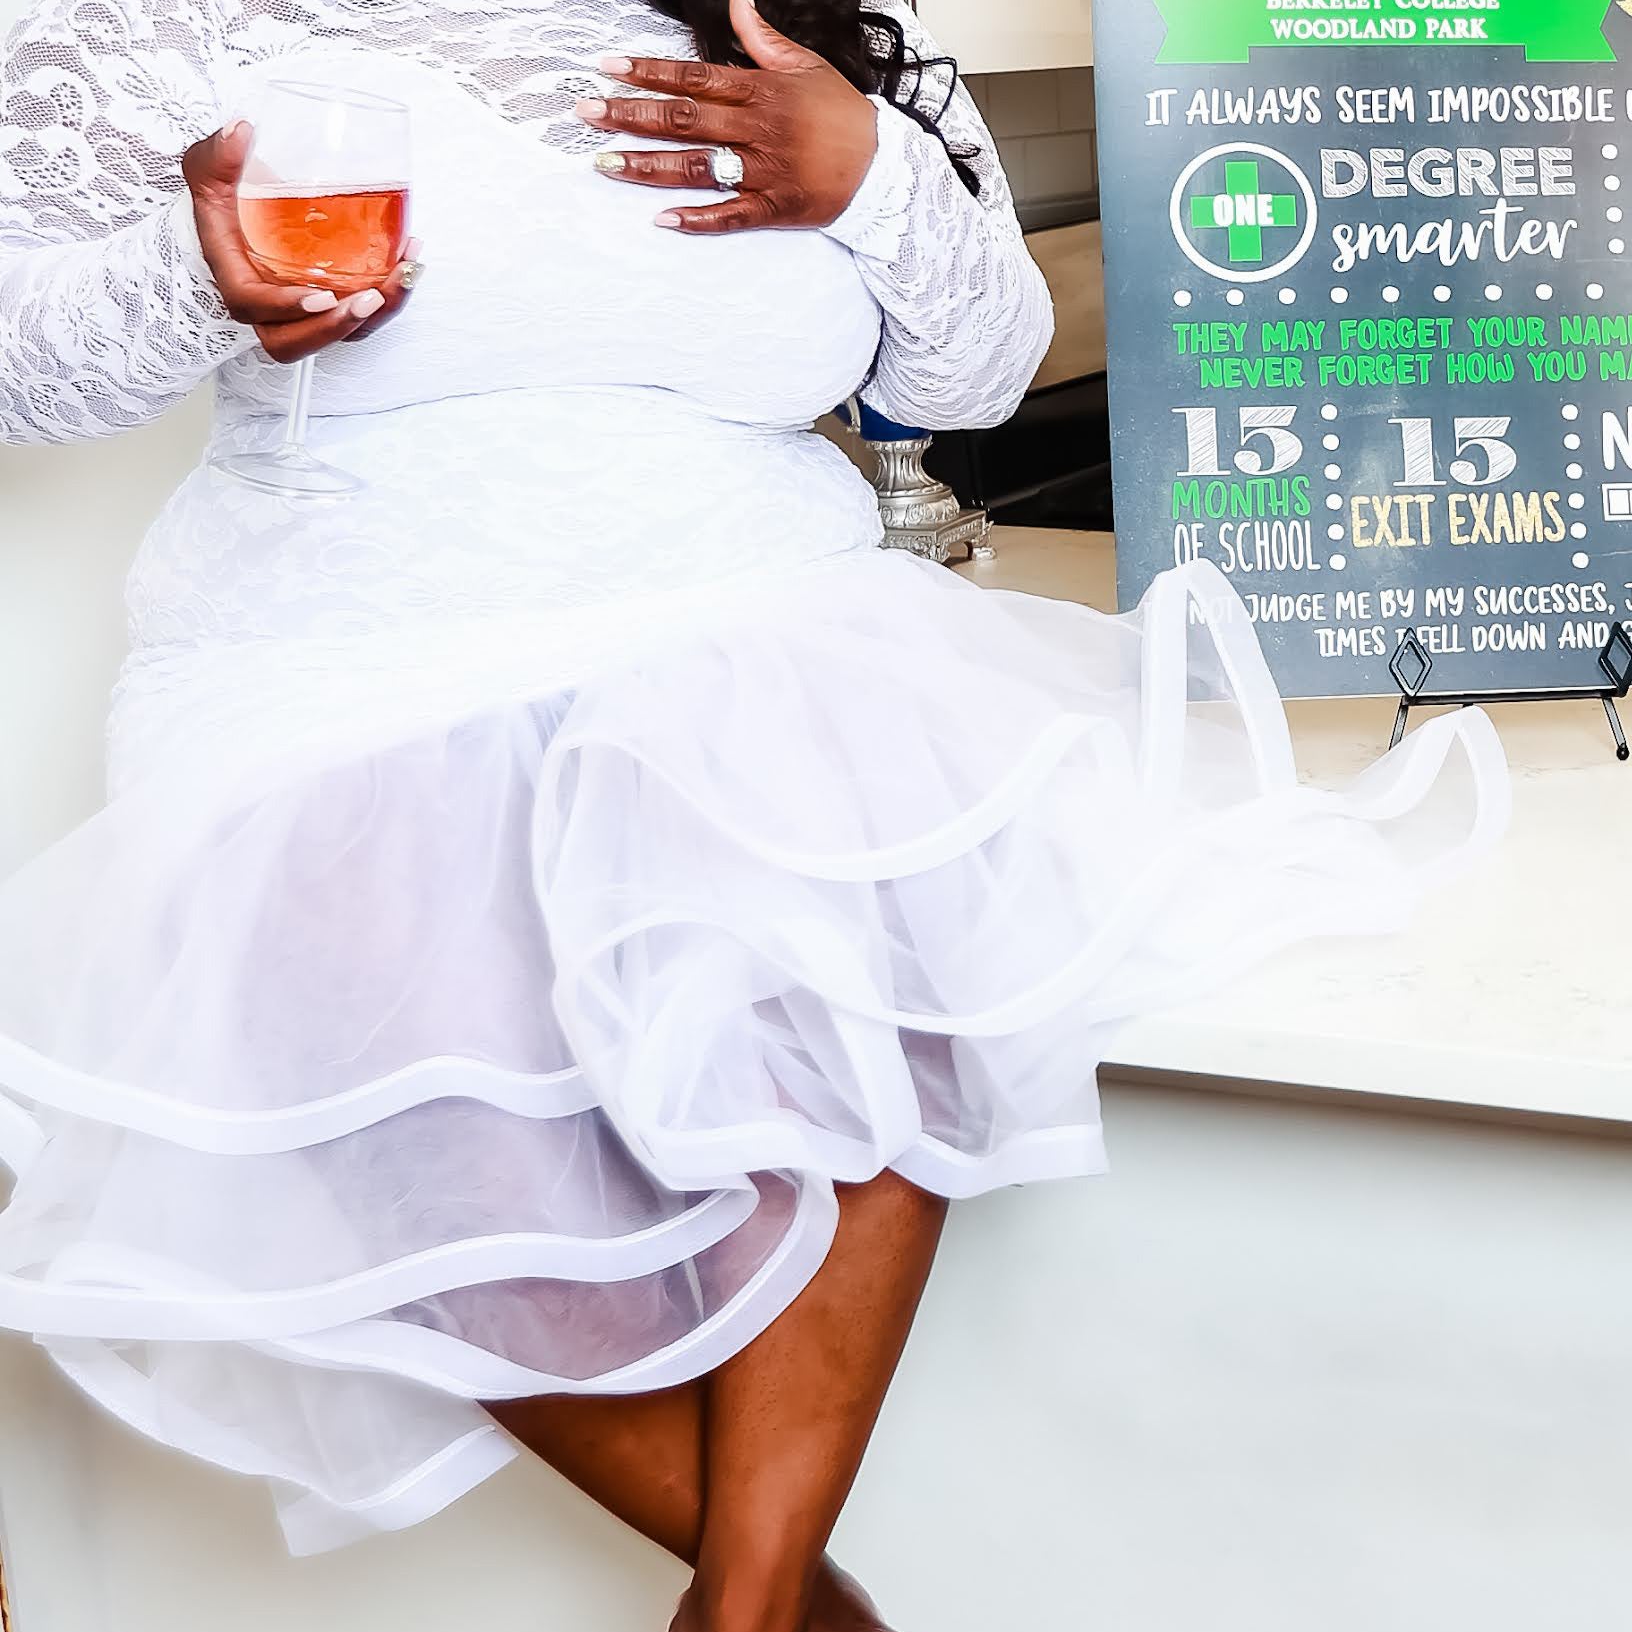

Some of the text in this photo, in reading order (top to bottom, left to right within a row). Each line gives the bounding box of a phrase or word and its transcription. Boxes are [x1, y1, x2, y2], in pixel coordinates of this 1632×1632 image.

[1272, 19, 1488, 40] WOODLAND PARK
[1145, 87, 1178, 125] IT
[1186, 85, 1322, 125] ALWAYS
[1335, 86, 1416, 124] SEEM
[1428, 85, 1614, 123] IMPOSSIBLE
[1321, 147, 1576, 198] DEGREE
[1212, 193, 1275, 226] ONE
[1332, 199, 1577, 272] smarter
[1173, 321, 1247, 354] THEY
[1263, 321, 1325, 353] MAY
[1341, 319, 1453, 351] FORGET
[1468, 318, 1547, 349] YOUR
[1201, 356, 1305, 390] NEVER
[1319, 355, 1432, 387] FORGET
[1448, 353, 1515, 385] HOW
[1527, 351, 1586, 384] YOU
[1172, 405, 1305, 477] 15
[1388, 416, 1518, 488] 15
[1172, 477, 1311, 520] MONTHS
[1351, 493, 1566, 549] EXIT EXAMS
[1172, 521, 1320, 574] OF SCHOOL
[1246, 593, 1326, 623] JUDGE
[1335, 591, 1372, 619] ME
[1380, 589, 1415, 617] BY
[1425, 587, 1467, 617] MY
[1473, 583, 1615, 616] SUCCESSES,
[1314, 627, 1386, 657] TIMES
[1416, 623, 1466, 654] FELL
[1473, 623, 1546, 651] DOWN
[1557, 621, 1610, 649] AND
